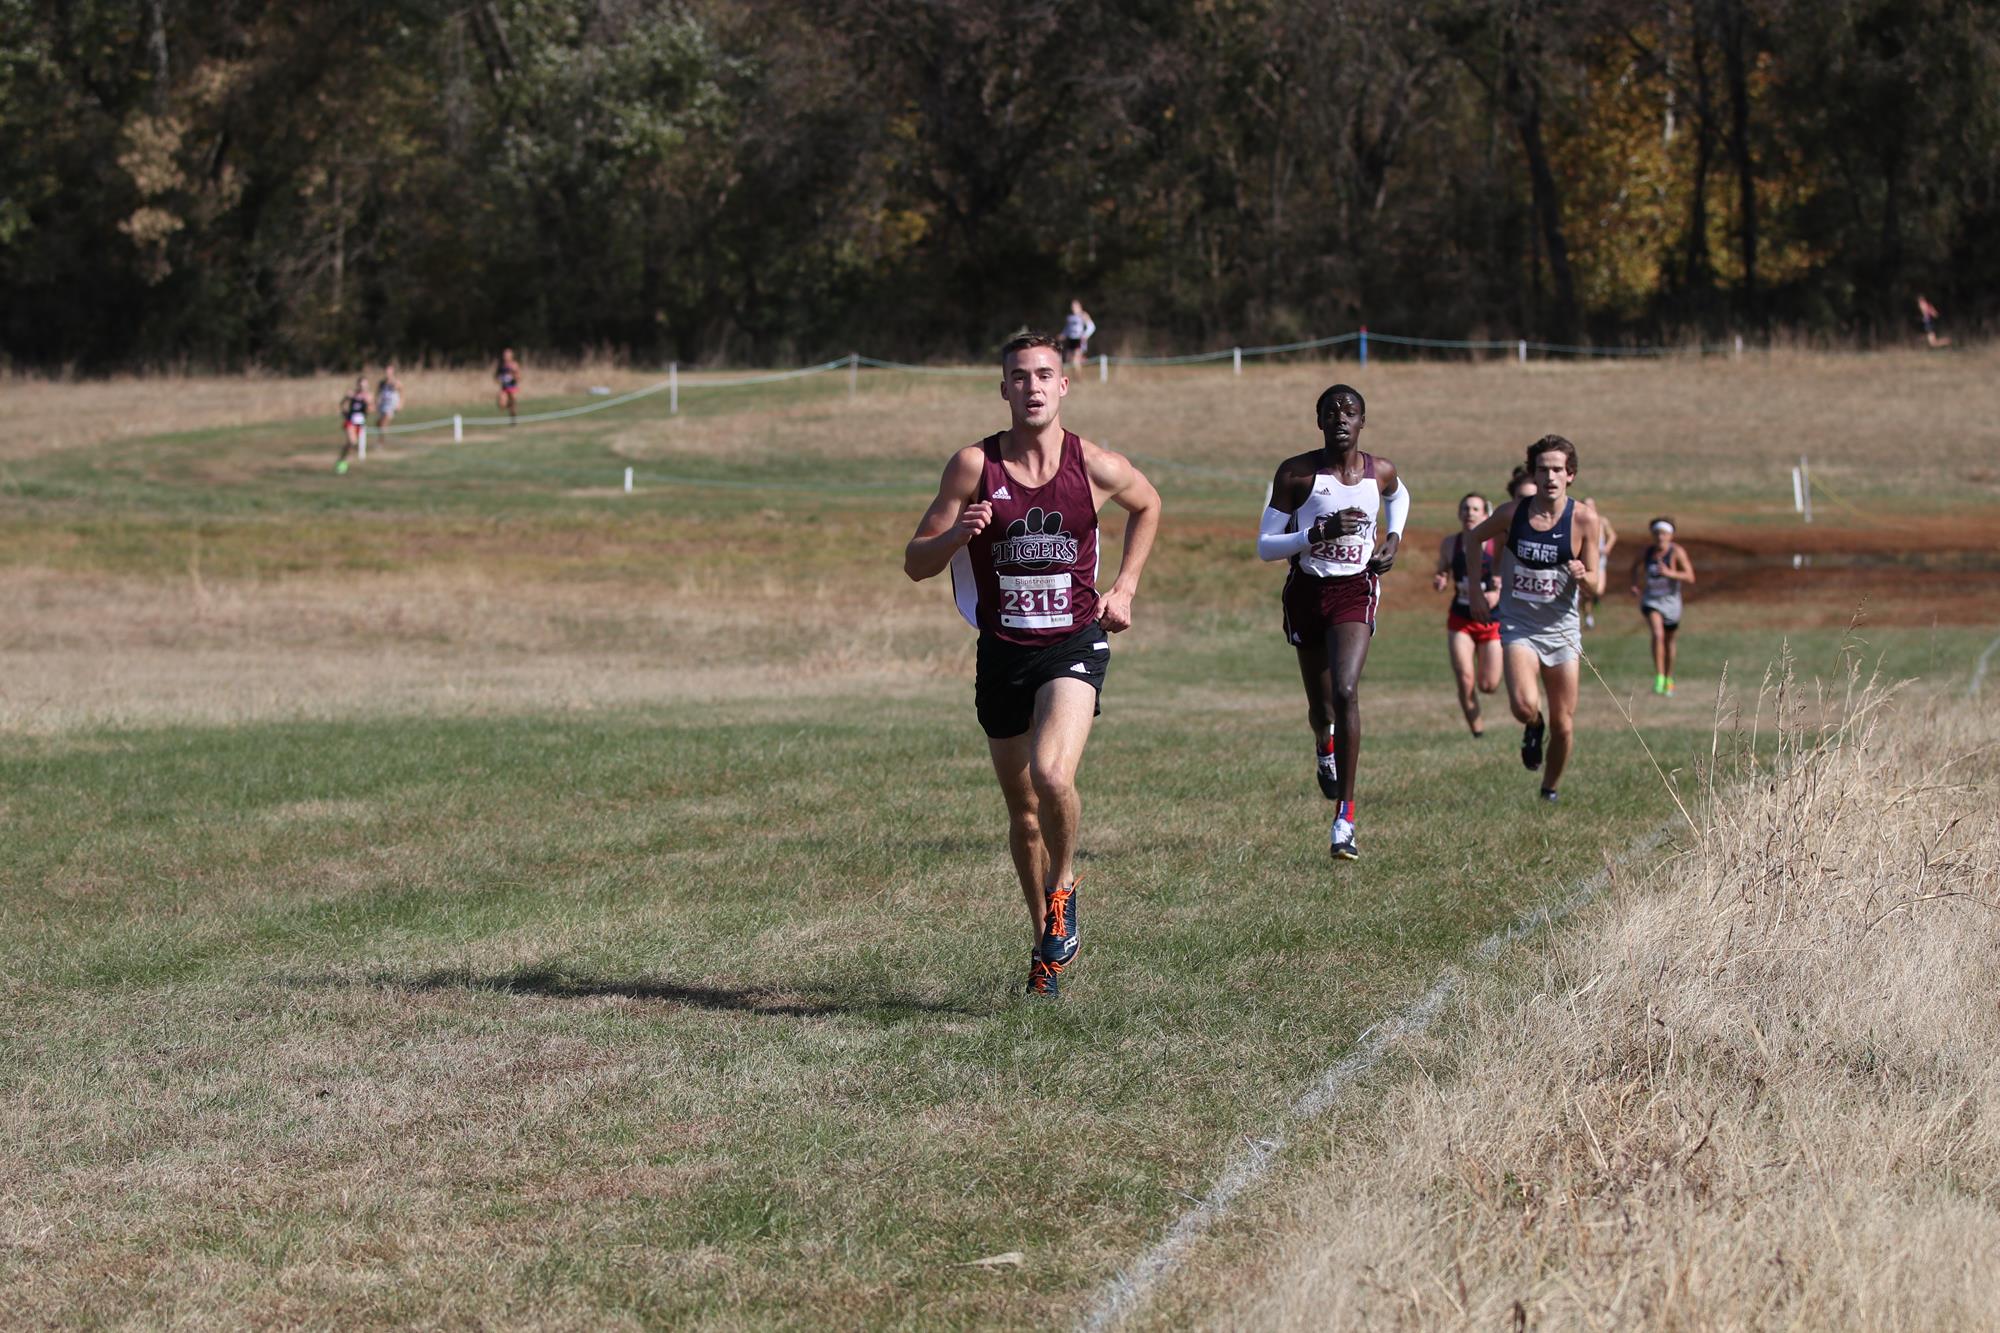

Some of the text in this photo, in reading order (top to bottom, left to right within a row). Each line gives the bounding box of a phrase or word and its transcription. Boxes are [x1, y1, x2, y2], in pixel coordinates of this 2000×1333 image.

[992, 540, 1078, 566] TIGERS
[1314, 541, 1360, 561] 2333
[1517, 546, 1558, 563] BEARS
[1015, 577, 1055, 586] Slipstream
[1515, 575, 1554, 592] 2464
[1004, 588, 1068, 612] 2315
